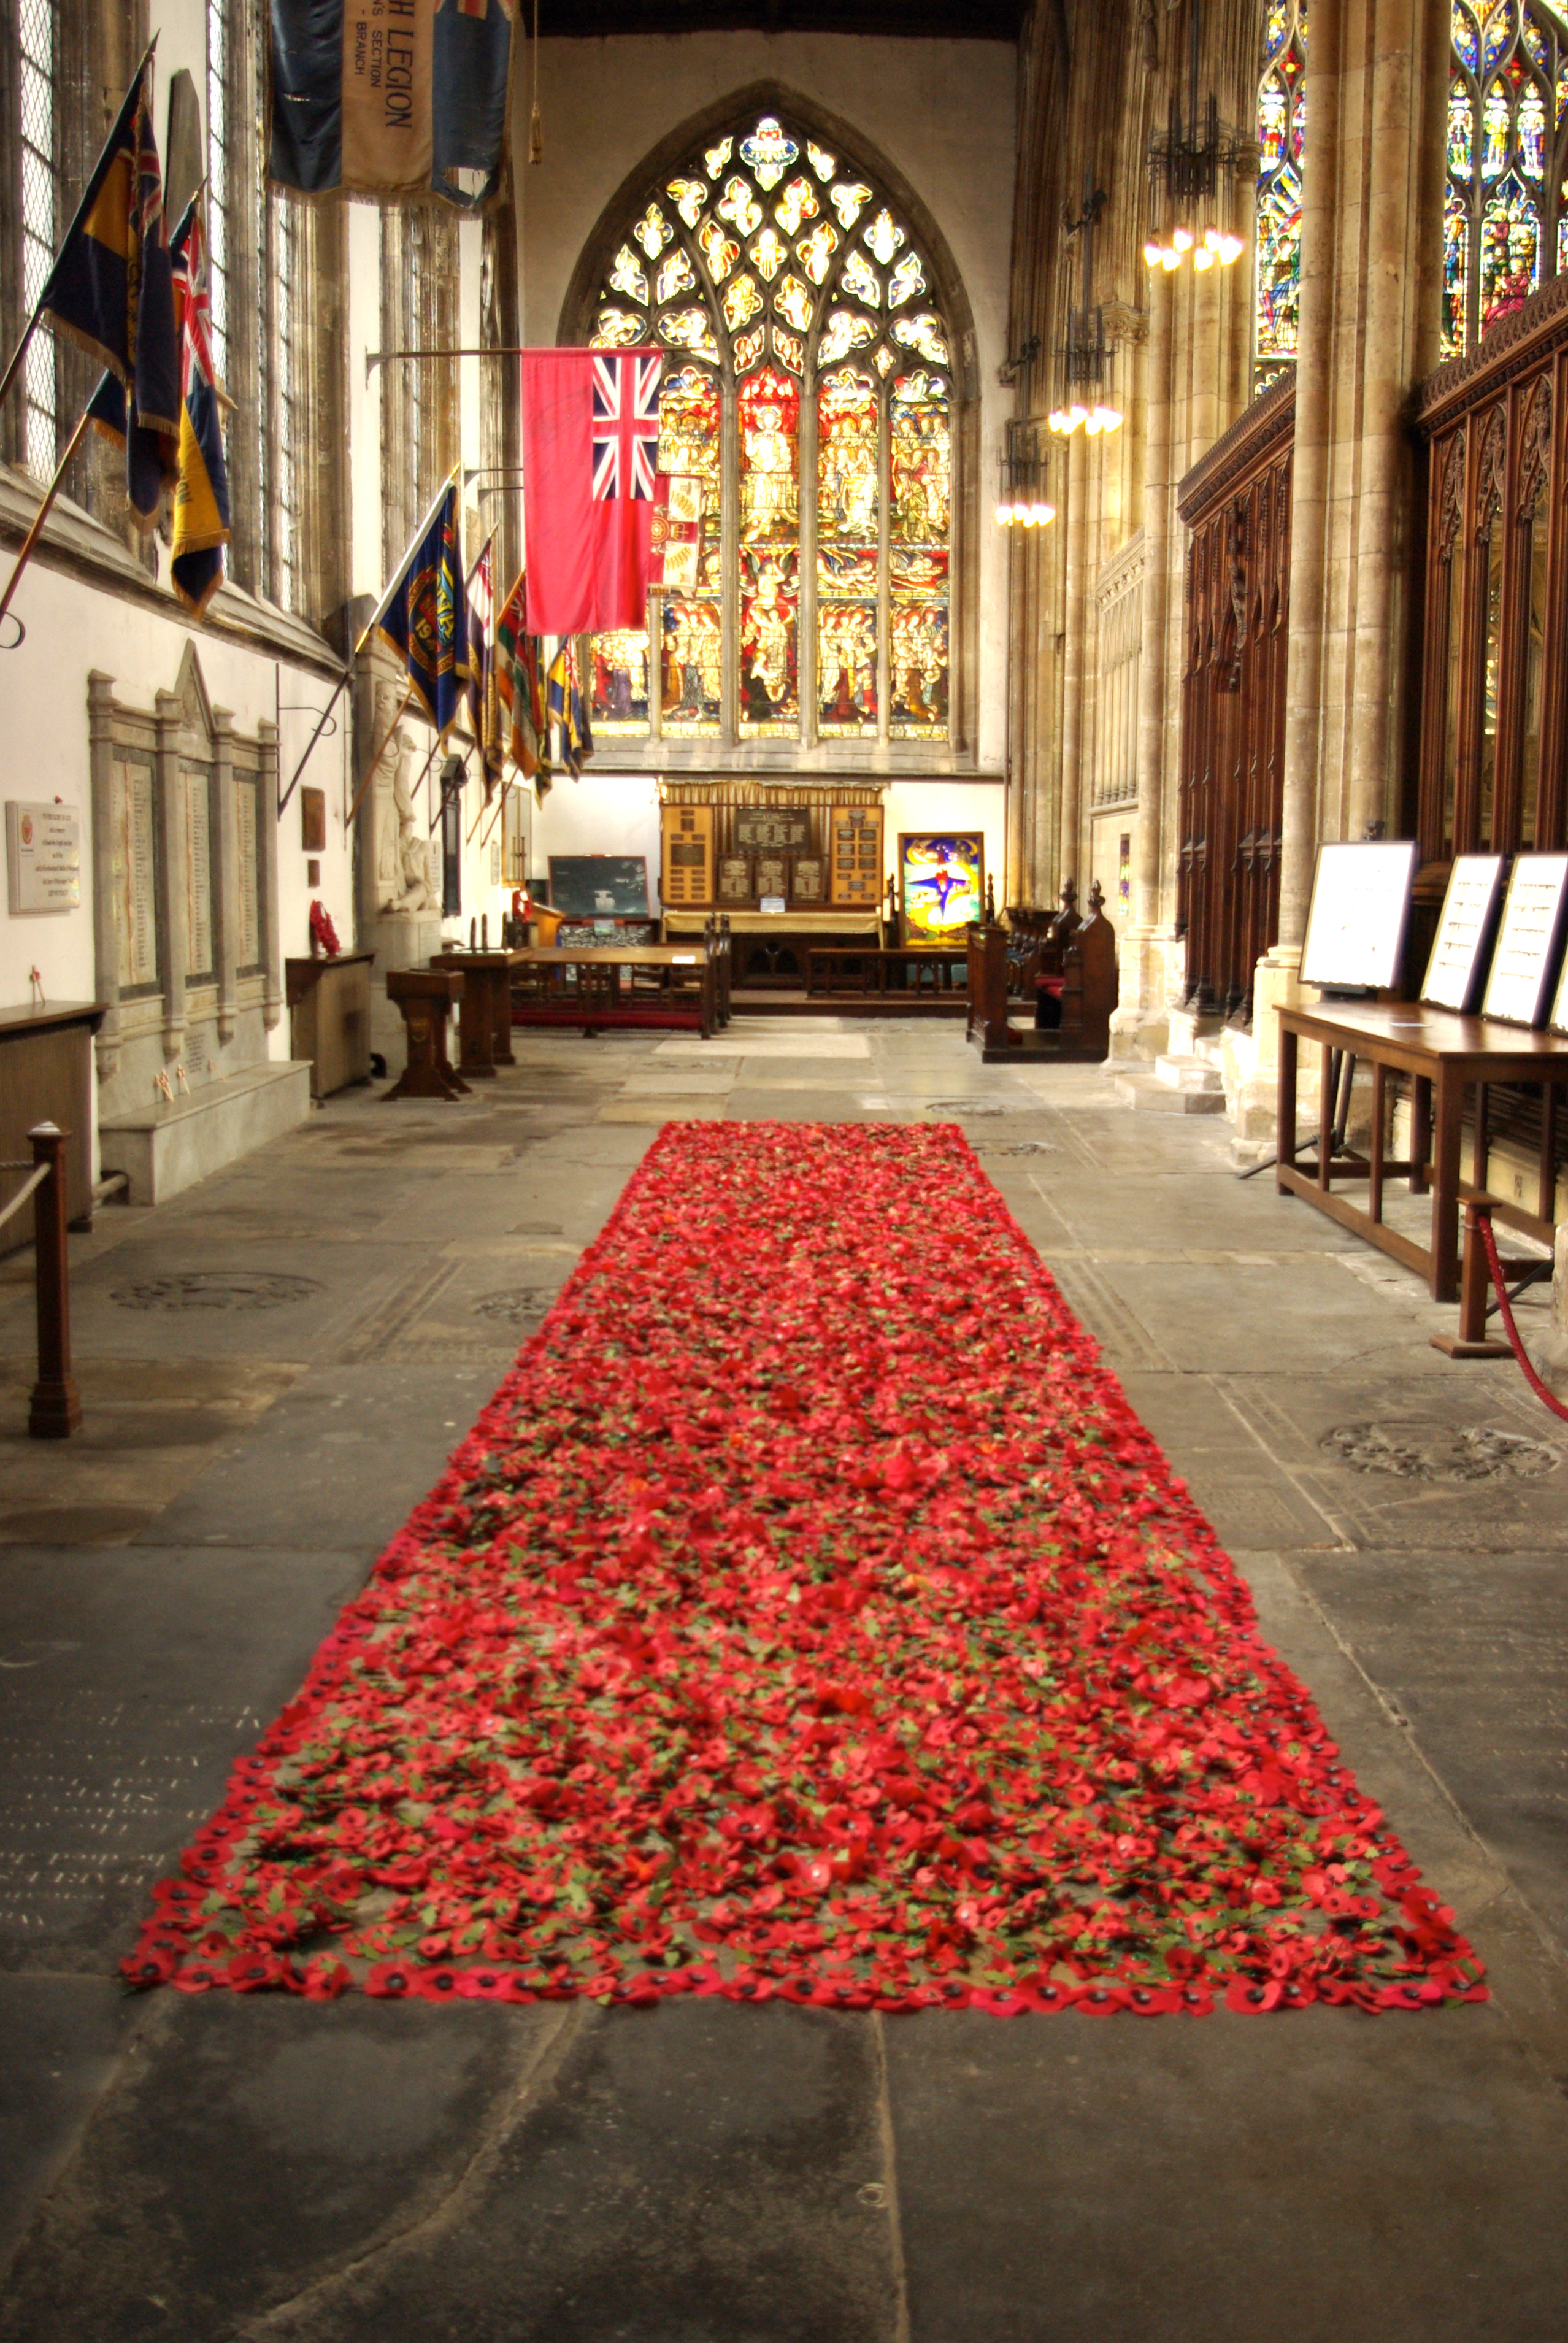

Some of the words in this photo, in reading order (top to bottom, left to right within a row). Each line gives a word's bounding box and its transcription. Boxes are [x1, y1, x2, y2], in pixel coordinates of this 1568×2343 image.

[355, 21, 367, 75] BRANCH
[370, 30, 383, 88] SECTION
[385, 29, 414, 128] LEGION
